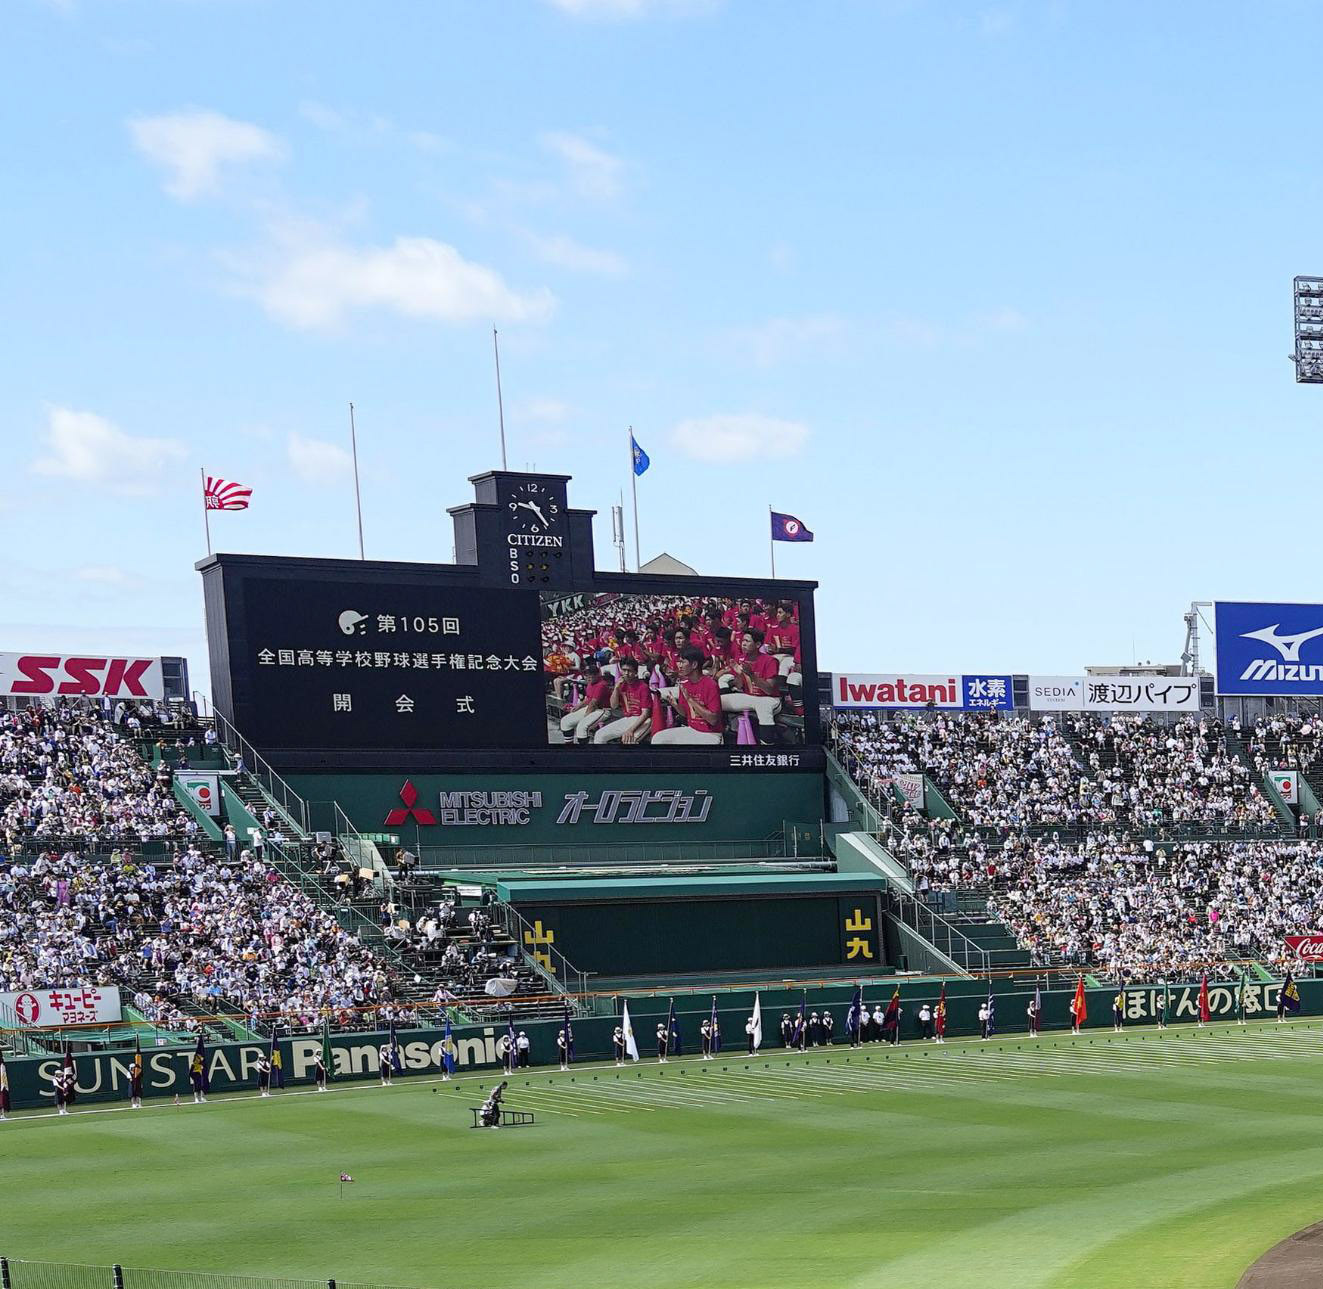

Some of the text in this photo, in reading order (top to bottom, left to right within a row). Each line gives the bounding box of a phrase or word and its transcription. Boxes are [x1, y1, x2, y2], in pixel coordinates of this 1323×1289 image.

[527, 484, 538, 492] 12
[508, 502, 518, 512] 9
[550, 504, 558, 514] 3
[530, 524, 540, 532] 6
[507, 534, 563, 547] CITIZEN
[510, 548, 518, 559] B
[510, 560, 518, 571] S
[547, 594, 584, 615] YKK
[377, 614, 461, 636] 第105回
[257, 648, 539, 672] 全国高等学校野球選手権記念大会
[10, 656, 153, 697] SSK
[839, 677, 956, 703] Iwatani
[968, 679, 1006, 698] 水素
[1035, 687, 1076, 697] SEDIA
[1088, 682, 1197, 705] 渡辺パイプ
[969, 698, 1006, 707] エネルギー
[730, 754, 800, 768] 三井住友銀行
[440, 791, 542, 809] MITSUBISHI
[557, 789, 714, 825] オーロラビジョン
[440, 808, 530, 826] ELECTRIC
[846, 909, 873, 959] 山九
[524, 921, 557, 974] 山九
[49, 988, 102, 1012] キューピー
[62, 1009, 97, 1023] マヨネーズ
[292, 1027, 512, 1078] Panasonic
